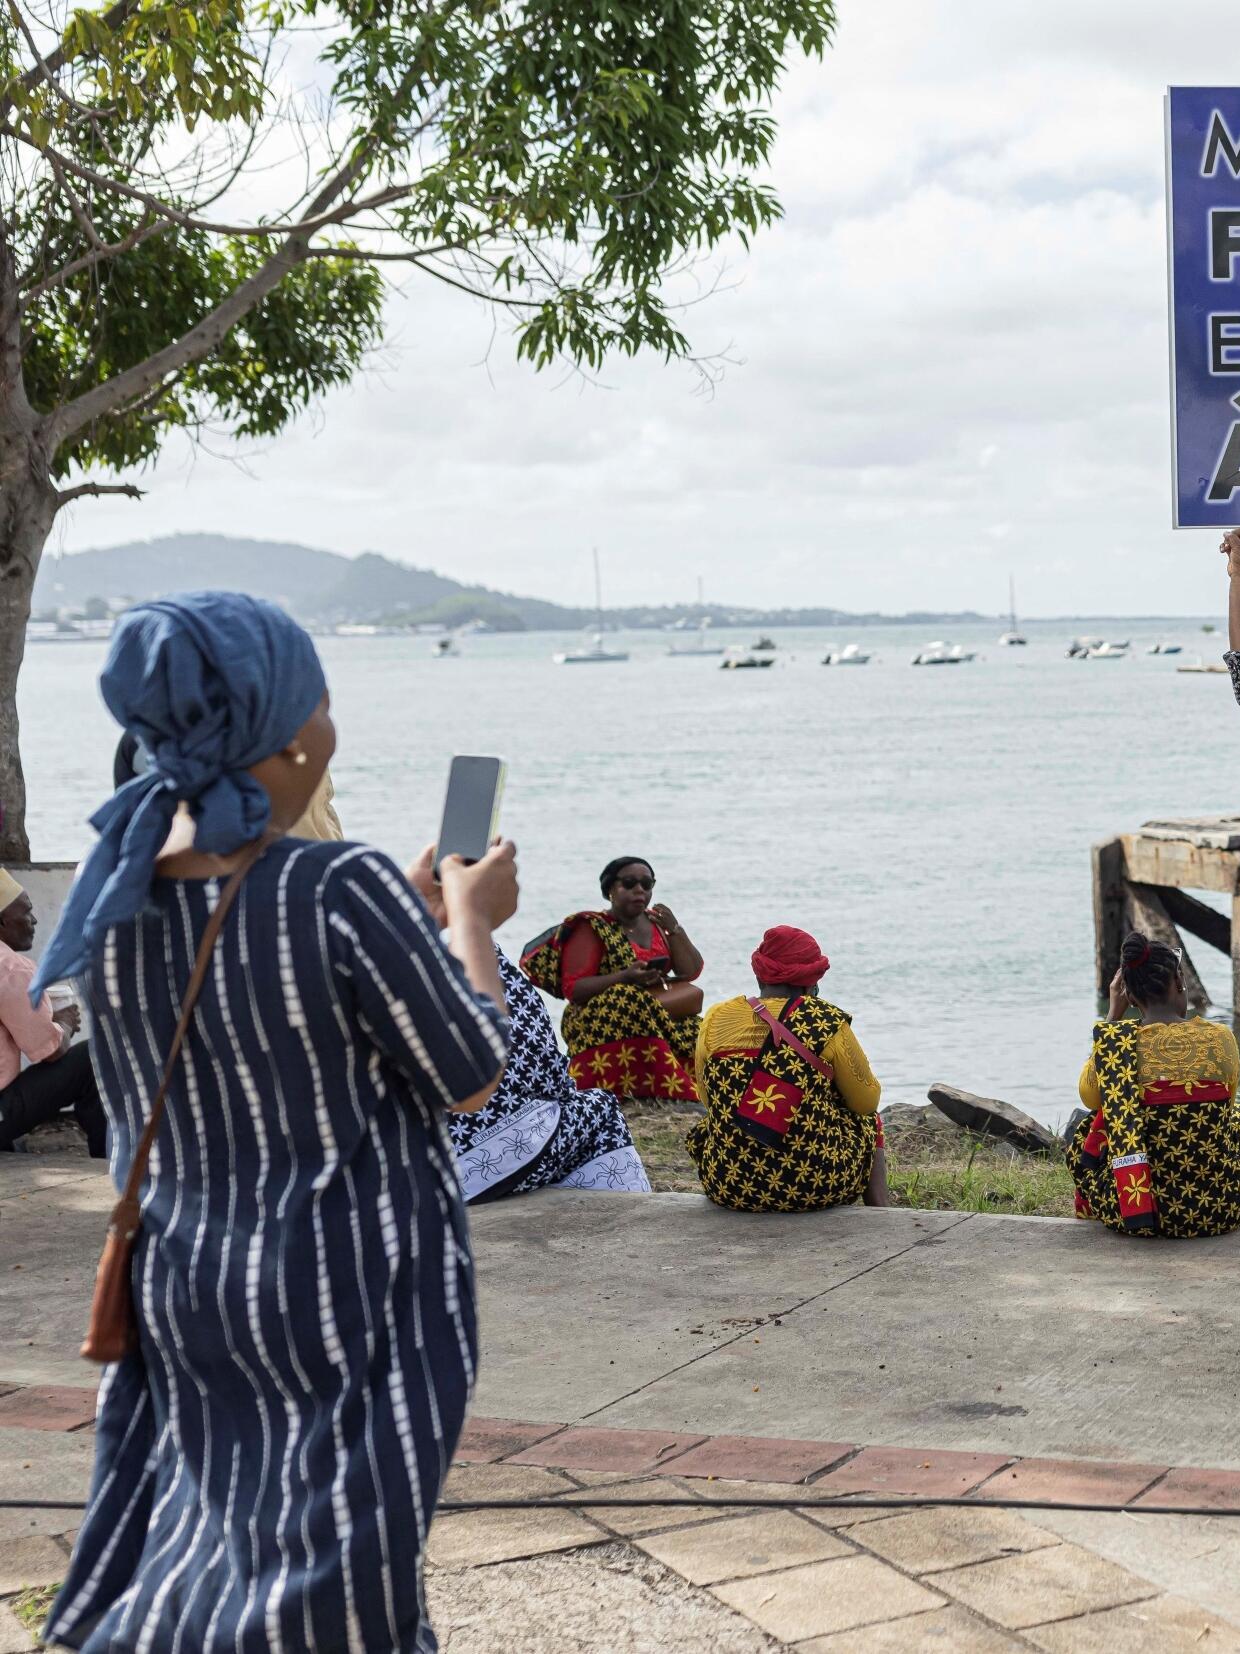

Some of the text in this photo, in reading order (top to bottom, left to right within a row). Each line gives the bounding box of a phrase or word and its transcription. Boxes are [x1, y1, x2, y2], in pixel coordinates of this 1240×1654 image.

[472, 1124, 502, 1144] FURAHA
[503, 1118, 514, 1126] YA
[1113, 1156, 1136, 1166] FURAHA
